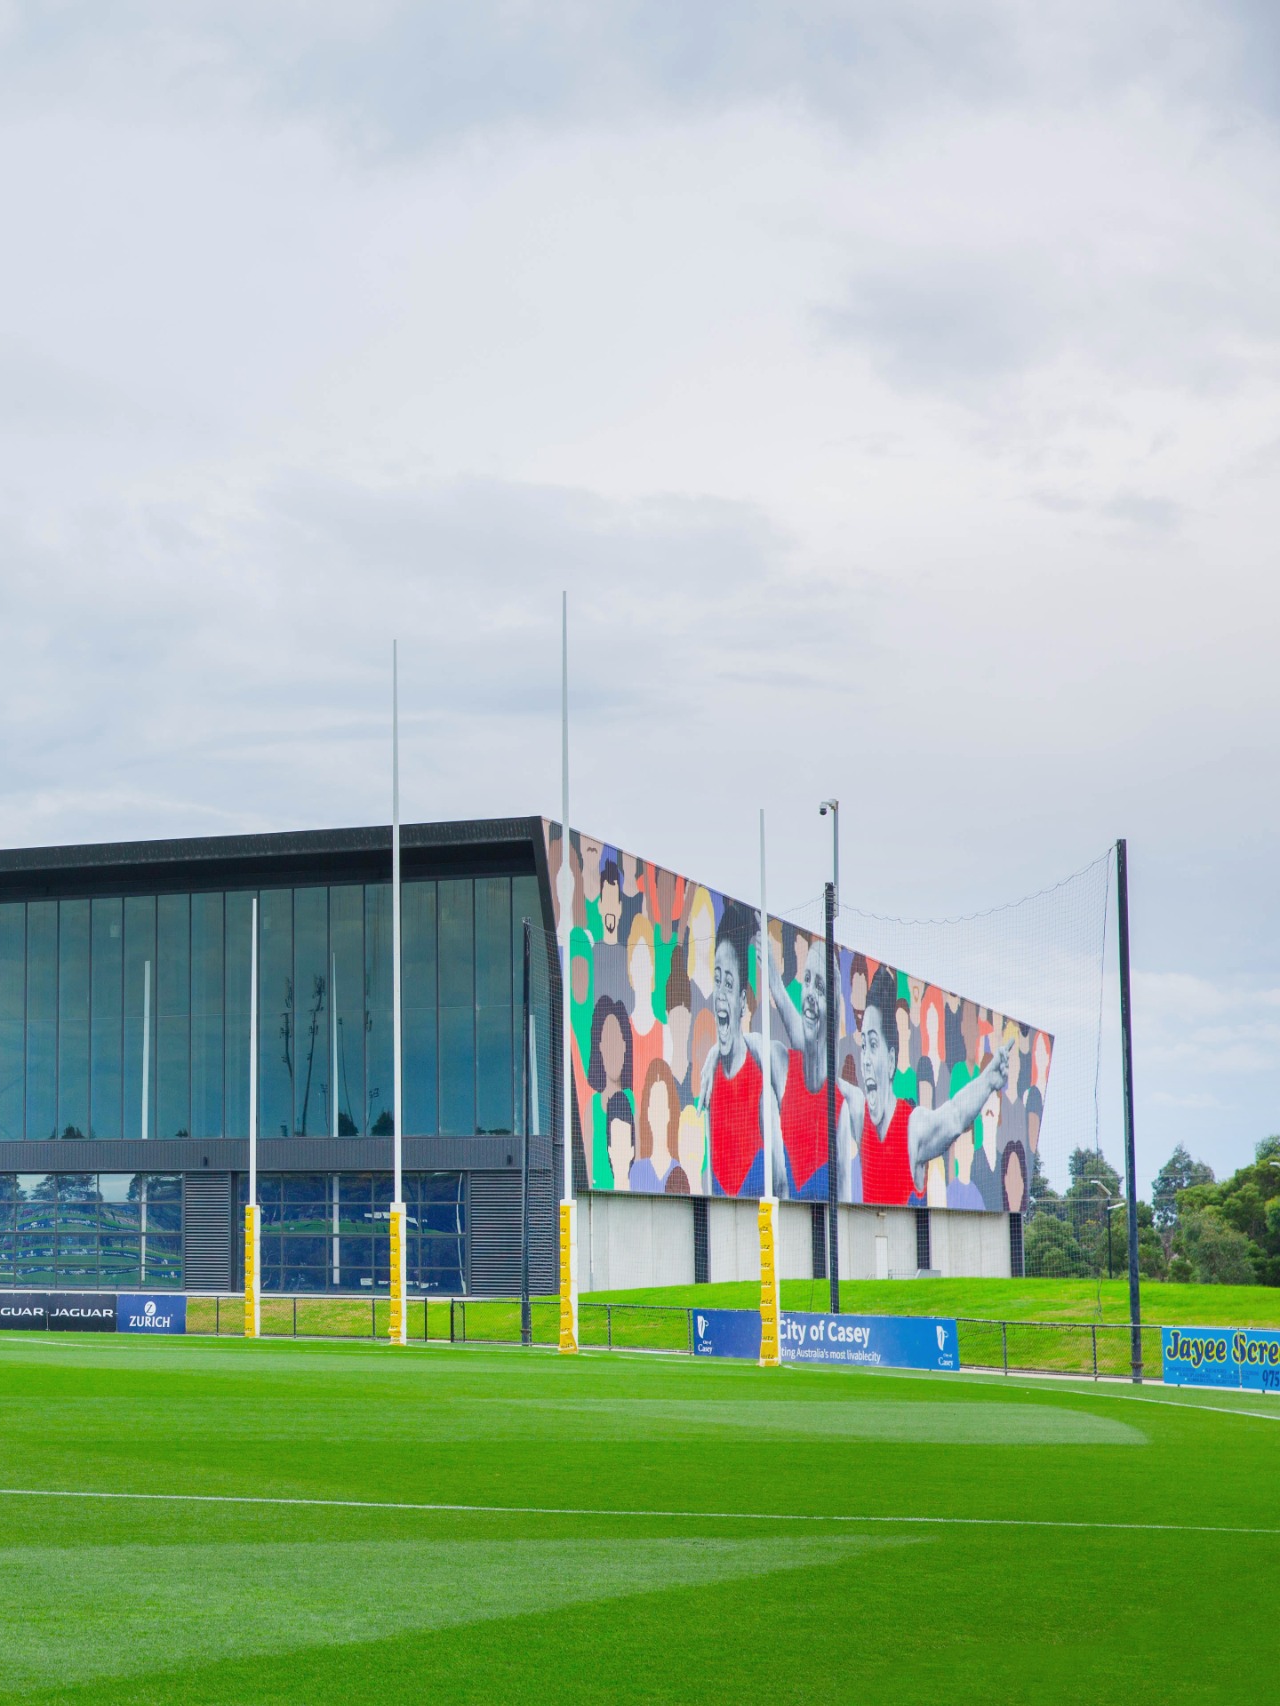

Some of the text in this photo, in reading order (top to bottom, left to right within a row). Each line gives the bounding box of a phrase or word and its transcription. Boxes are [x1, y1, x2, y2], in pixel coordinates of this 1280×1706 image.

[50, 1308, 114, 1318] JAGUAR
[129, 1316, 170, 1328] ZURICH
[780, 1319, 871, 1349] City of Casey
[698, 1343, 713, 1355] Casey
[781, 1347, 796, 1360] ting
[796, 1347, 829, 1359] Australia's
[830, 1350, 846, 1360] most
[1166, 1330, 1280, 1368] Jayee Scre
[938, 1357, 953, 1369] Casey
